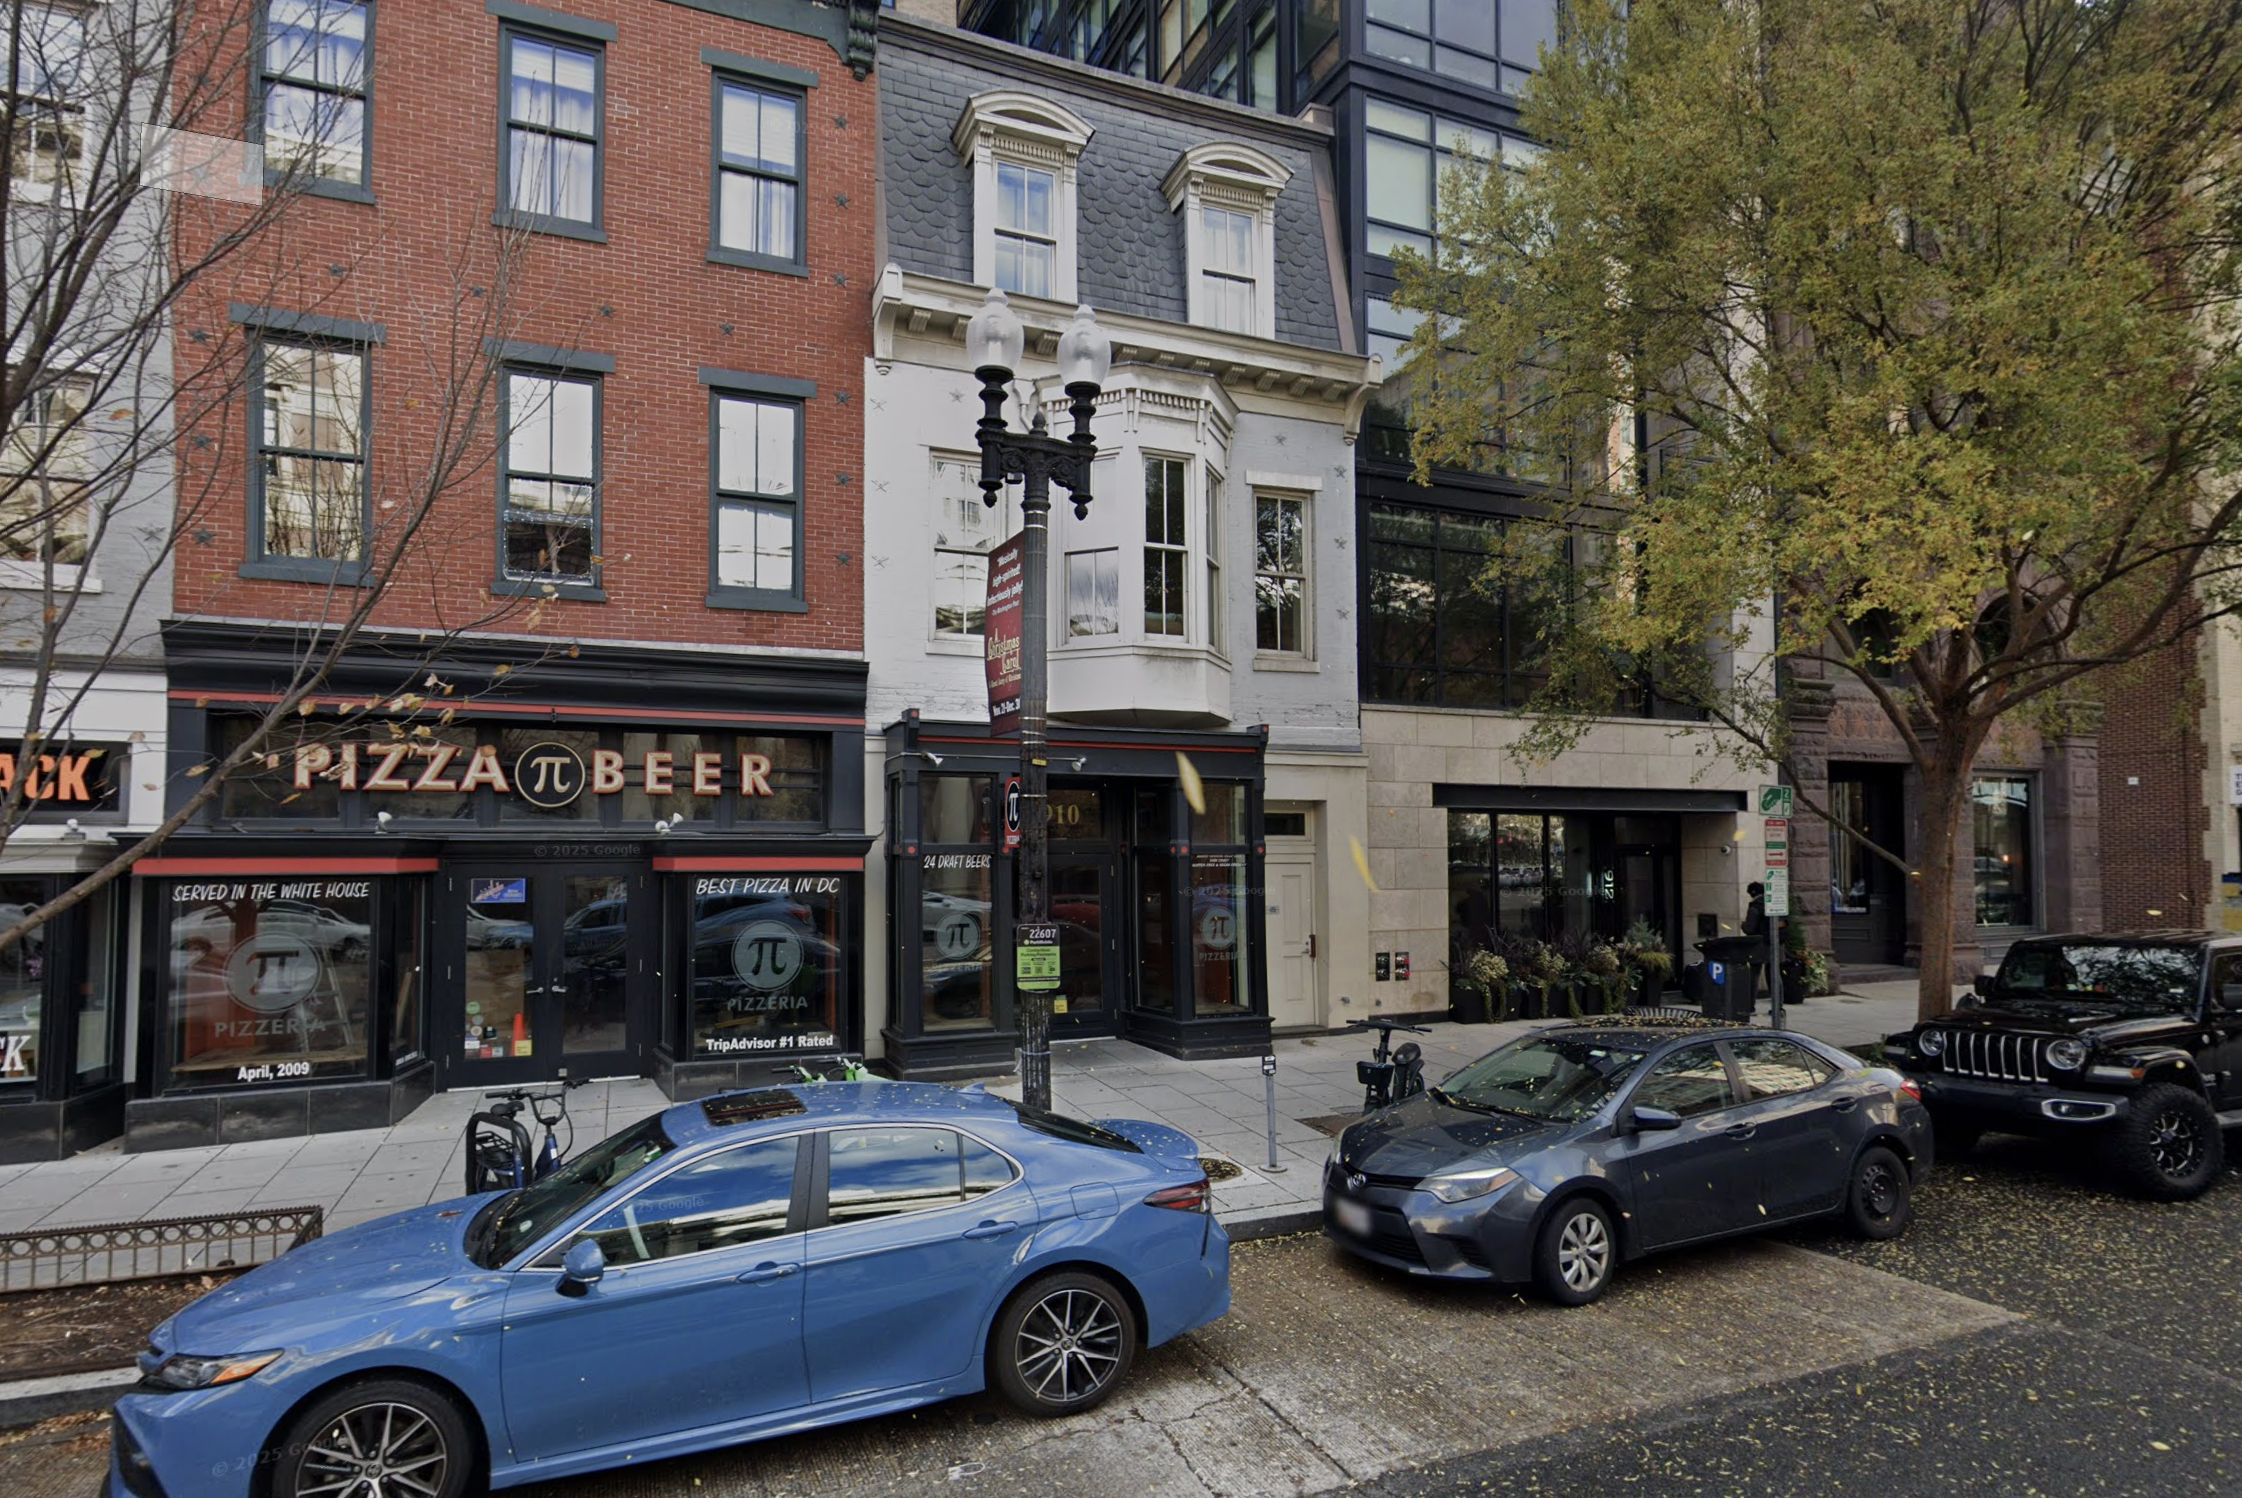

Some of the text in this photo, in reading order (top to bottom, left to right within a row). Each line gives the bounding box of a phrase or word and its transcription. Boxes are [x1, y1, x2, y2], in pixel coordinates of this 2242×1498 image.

[988, 634, 1020, 660] Christmas
[1001, 649, 1021, 673] Carol
[294, 742, 511, 791] PIZZA
[592, 750, 774, 796] BEER
[923, 854, 992, 868] 24 DRAFT BEERS
[172, 882, 370, 901] SERVED IN THE WHITE HOUSE
[696, 878, 840, 894] BEST PIZZA IN DC
[1604, 870, 1614, 899] 912
[1030, 929, 1056, 938] 22607
[727, 996, 808, 1011] PIZZERIA
[215, 1018, 326, 1037] PIZZERIA
[706, 1035, 834, 1053] TripAdvisor #1 Rated
[237, 1062, 310, 1082] April, 2009
